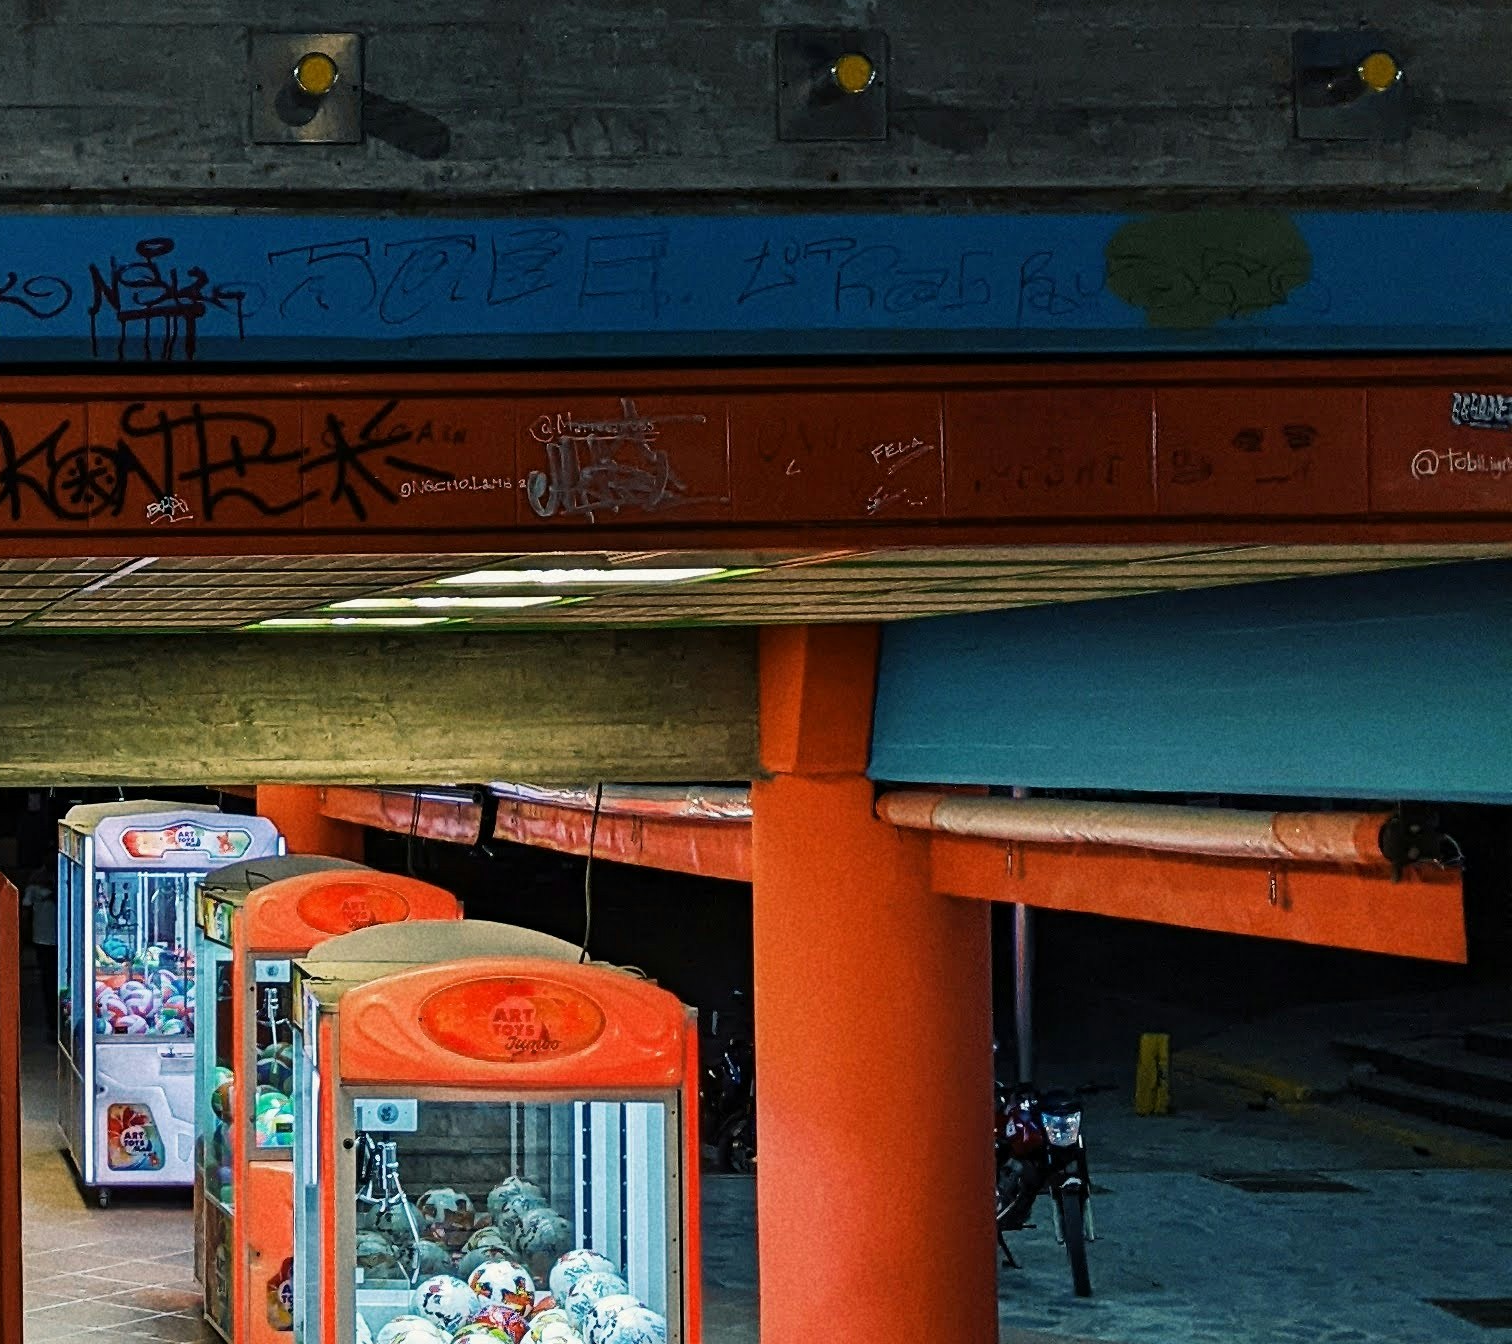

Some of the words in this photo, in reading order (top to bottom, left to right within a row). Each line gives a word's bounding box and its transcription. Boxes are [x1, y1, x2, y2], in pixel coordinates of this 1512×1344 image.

[492, 1007, 535, 1023] ART
[492, 1023, 535, 1037] TOYS
[504, 1035, 561, 1051] Jumbo
[124, 1131, 145, 1140] ART
